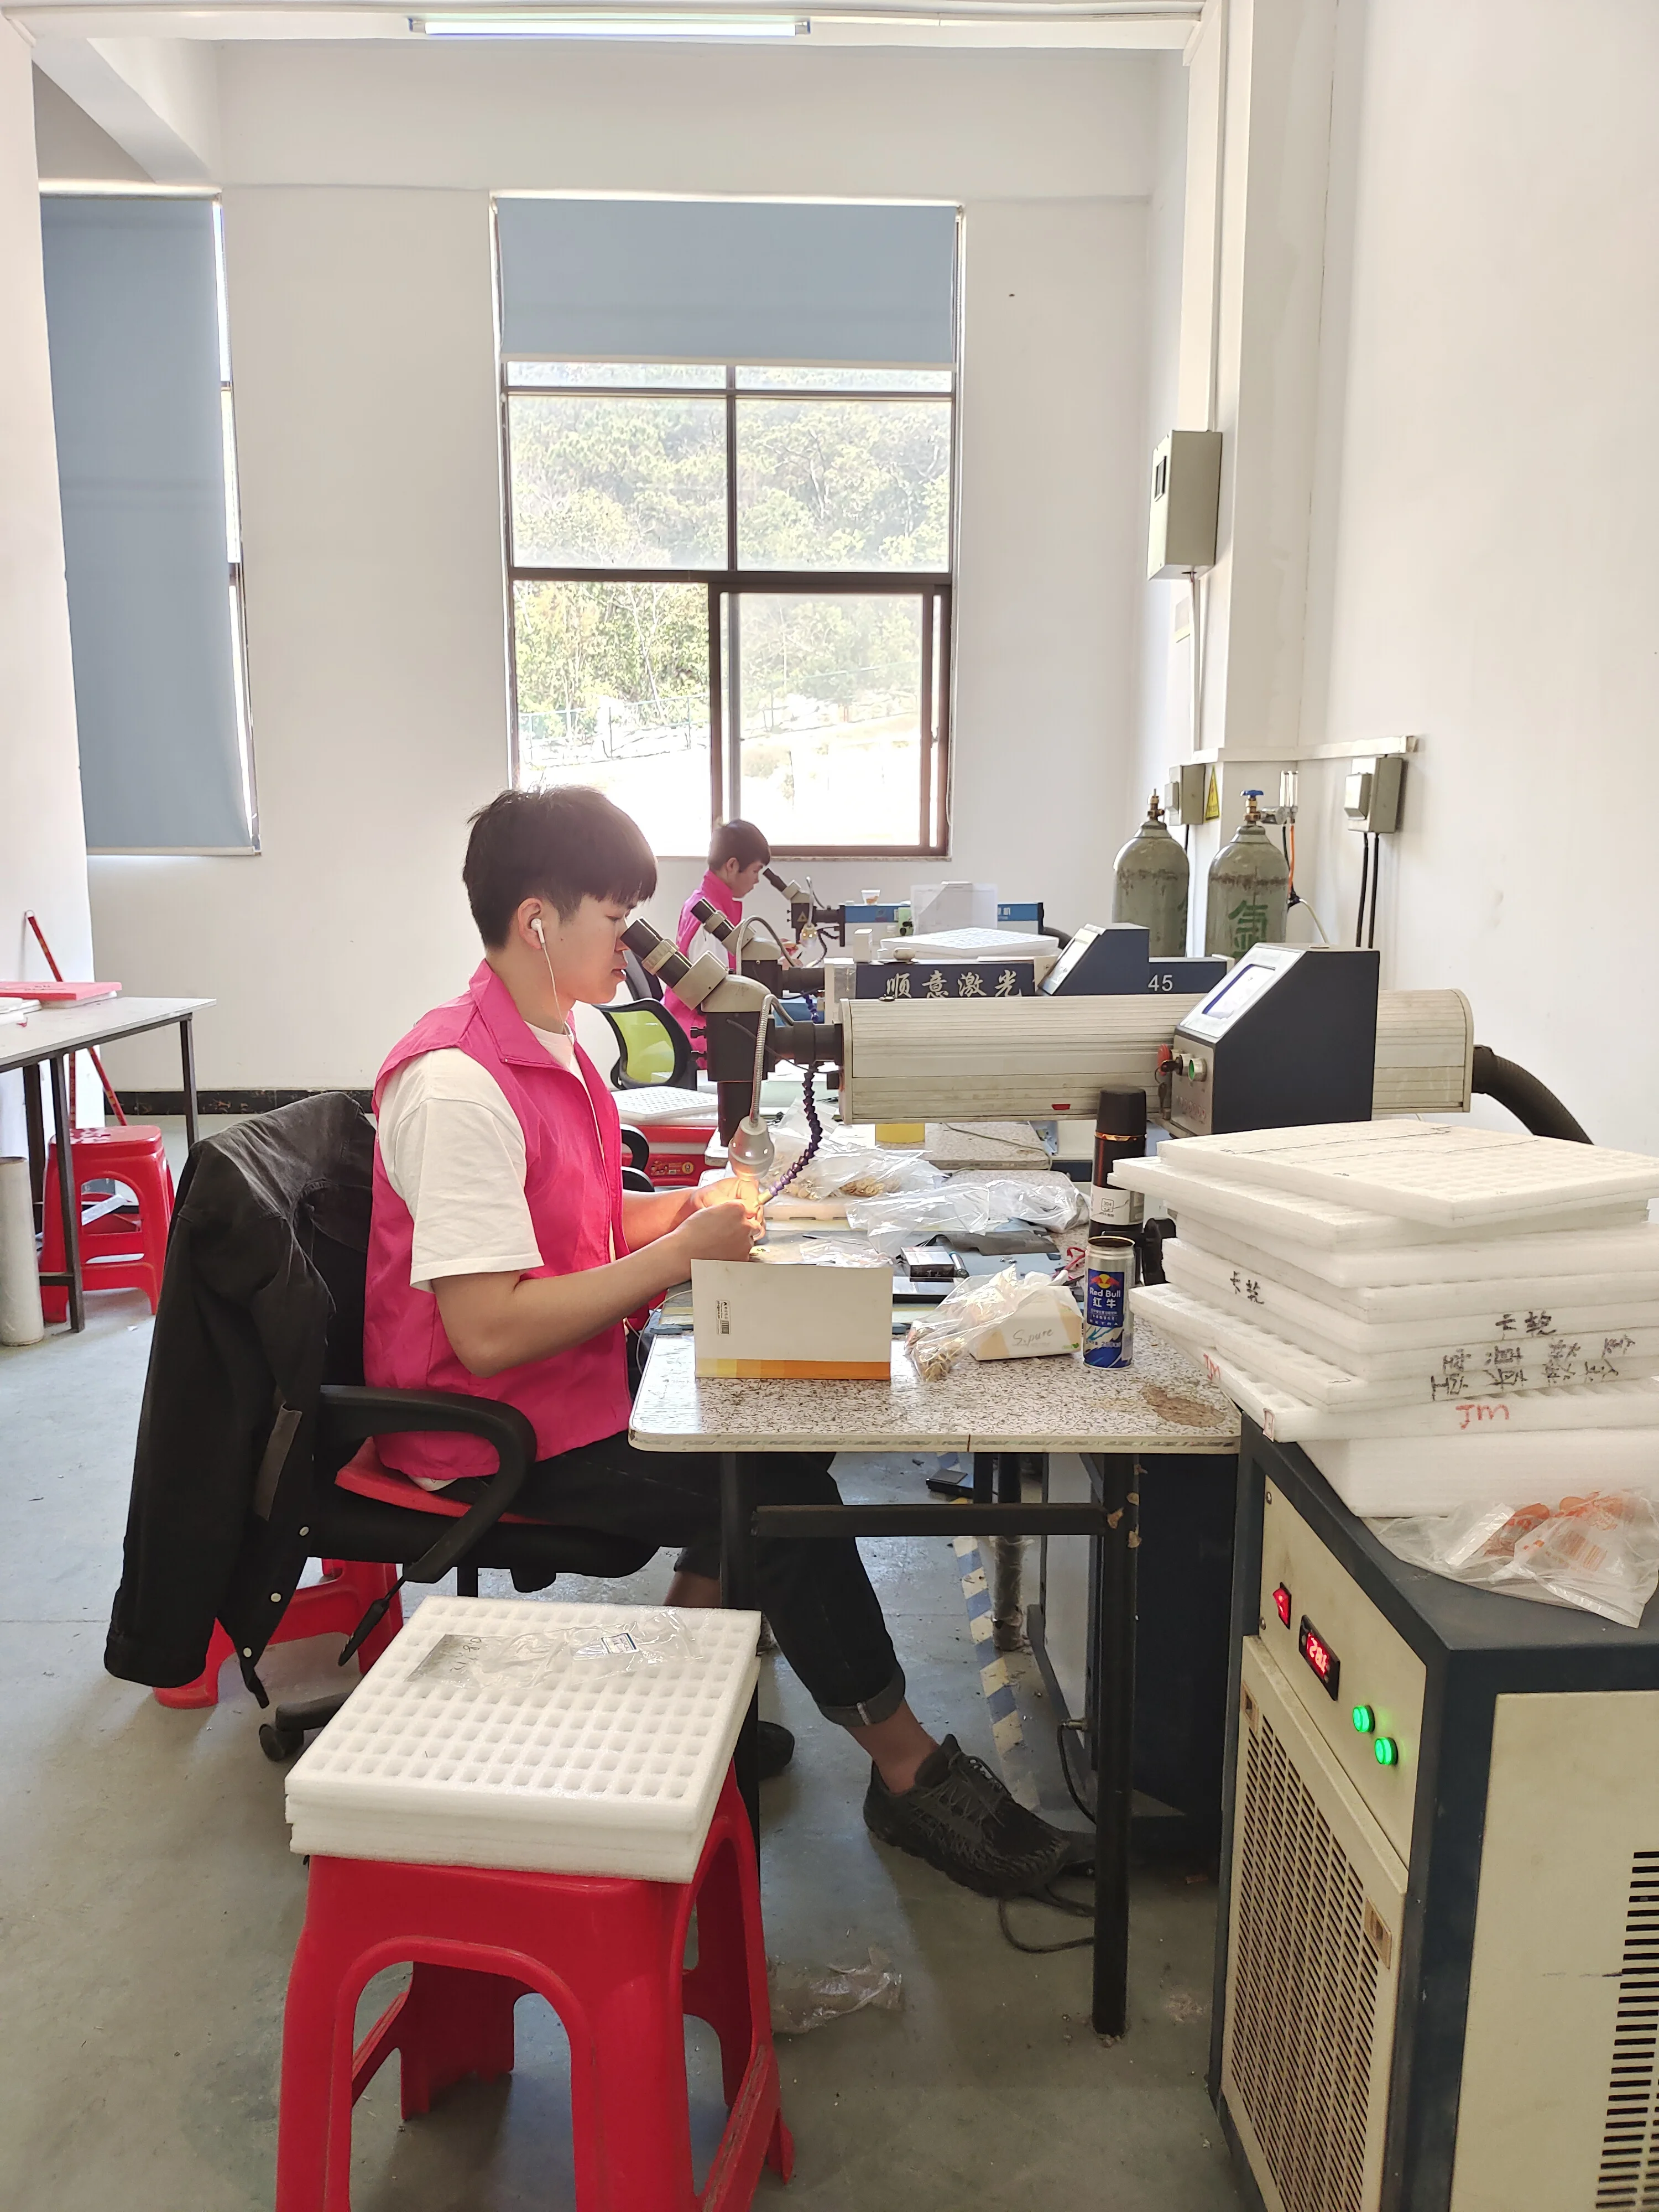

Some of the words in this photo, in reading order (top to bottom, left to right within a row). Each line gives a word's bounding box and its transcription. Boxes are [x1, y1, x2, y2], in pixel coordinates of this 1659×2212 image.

[886, 969, 1022, 999] 顺意激光
[1147, 974, 1173, 992] 45
[1089, 1287, 1103, 1297] Red
[1105, 1290, 1121, 1298] Bull
[1093, 1297, 1117, 1308] 红牛
